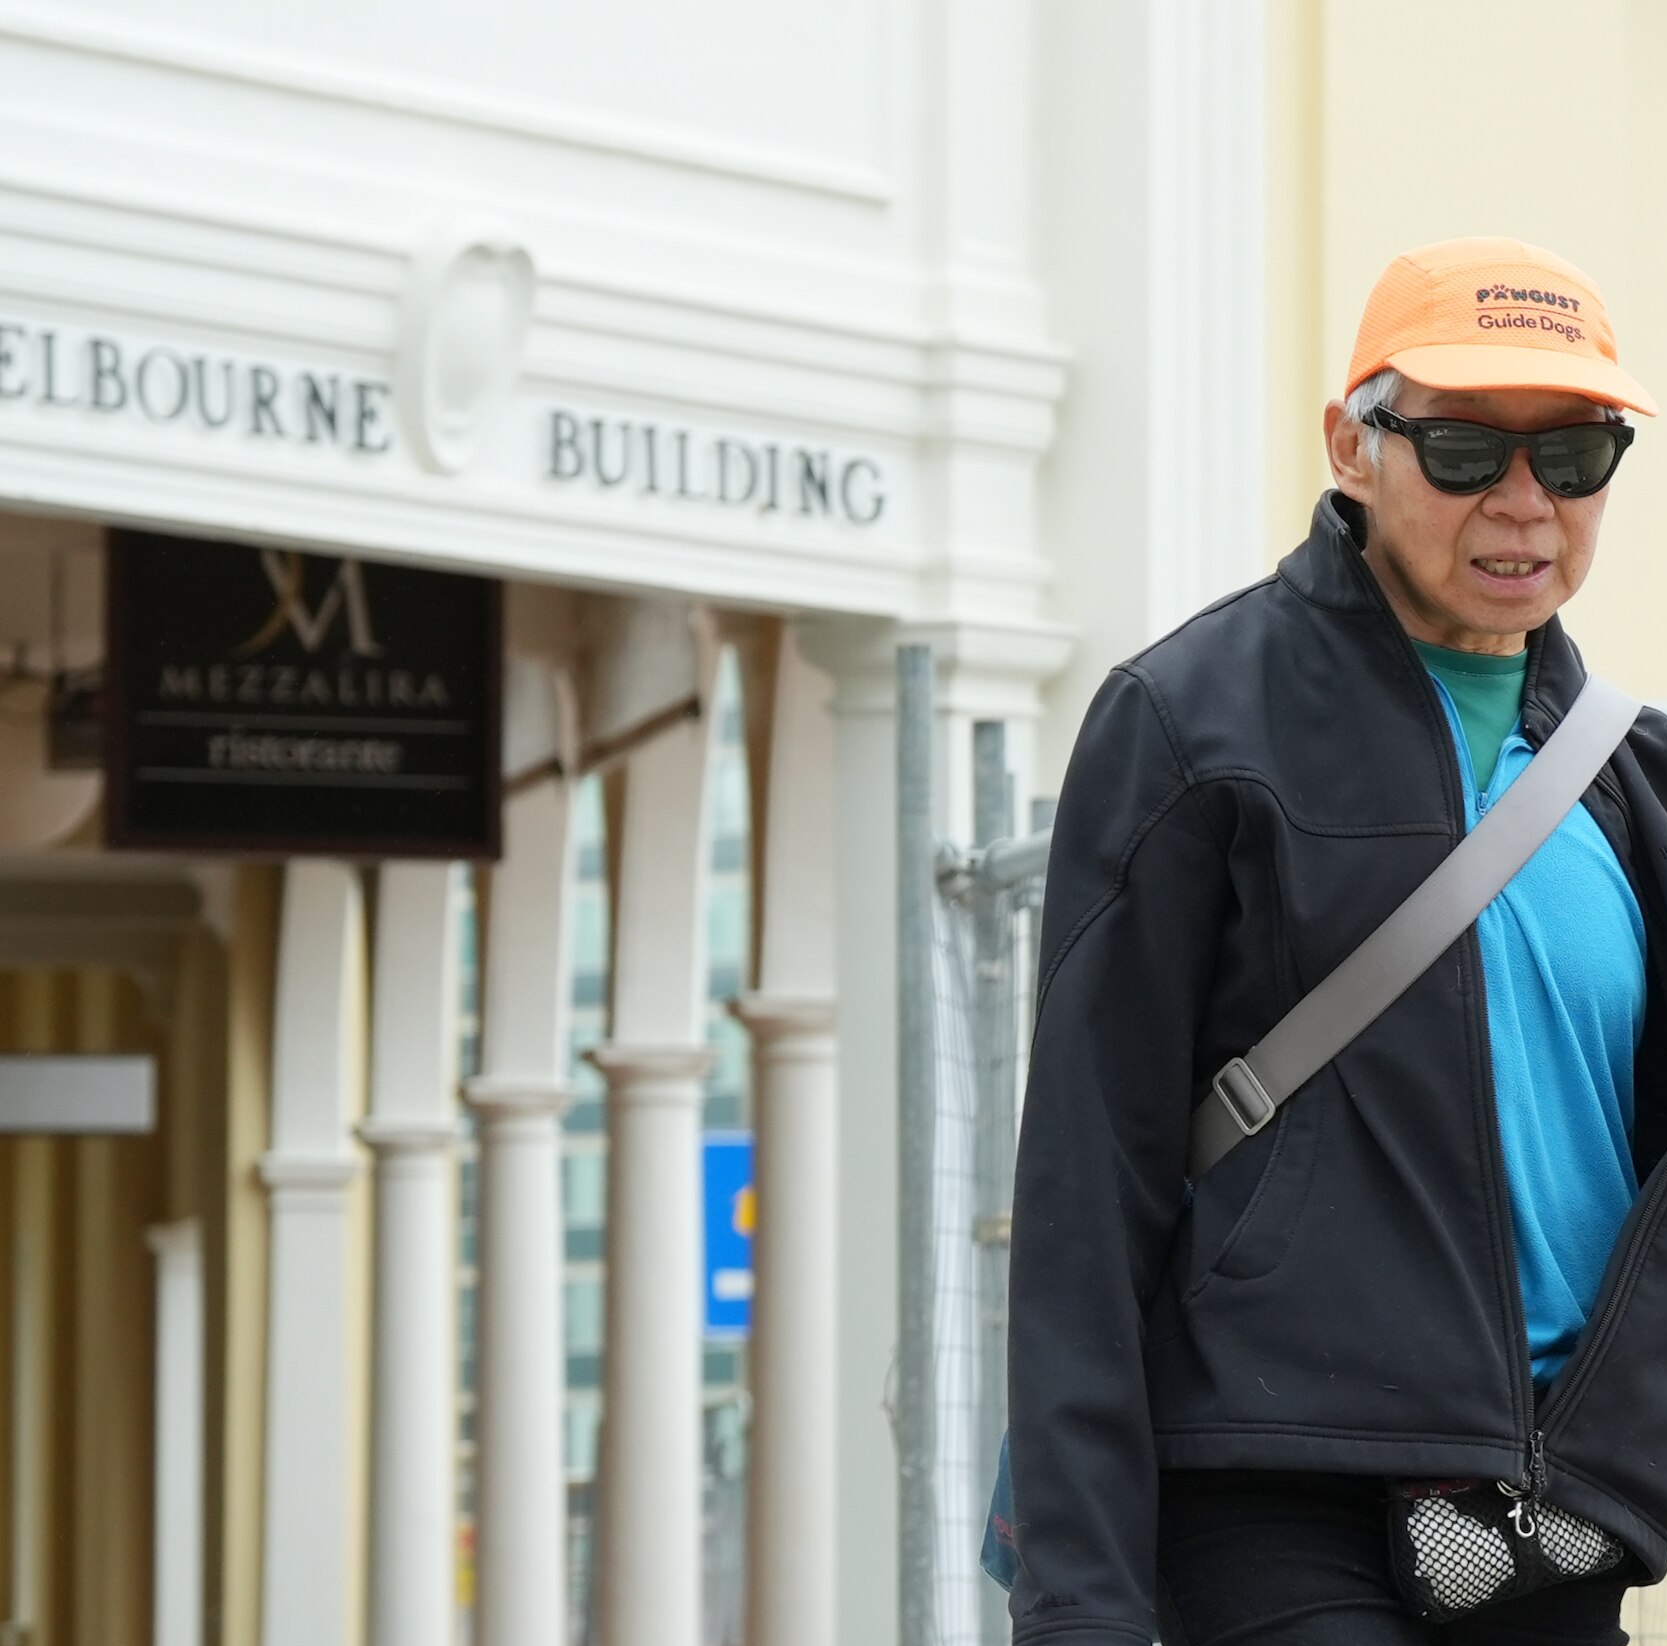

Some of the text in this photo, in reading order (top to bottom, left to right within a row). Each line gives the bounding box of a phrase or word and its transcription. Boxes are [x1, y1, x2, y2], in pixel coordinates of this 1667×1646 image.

[1477, 313, 1537, 329] Guide
[549, 410, 885, 526] BUILDING
[159, 663, 450, 709] MEZZALIRA
